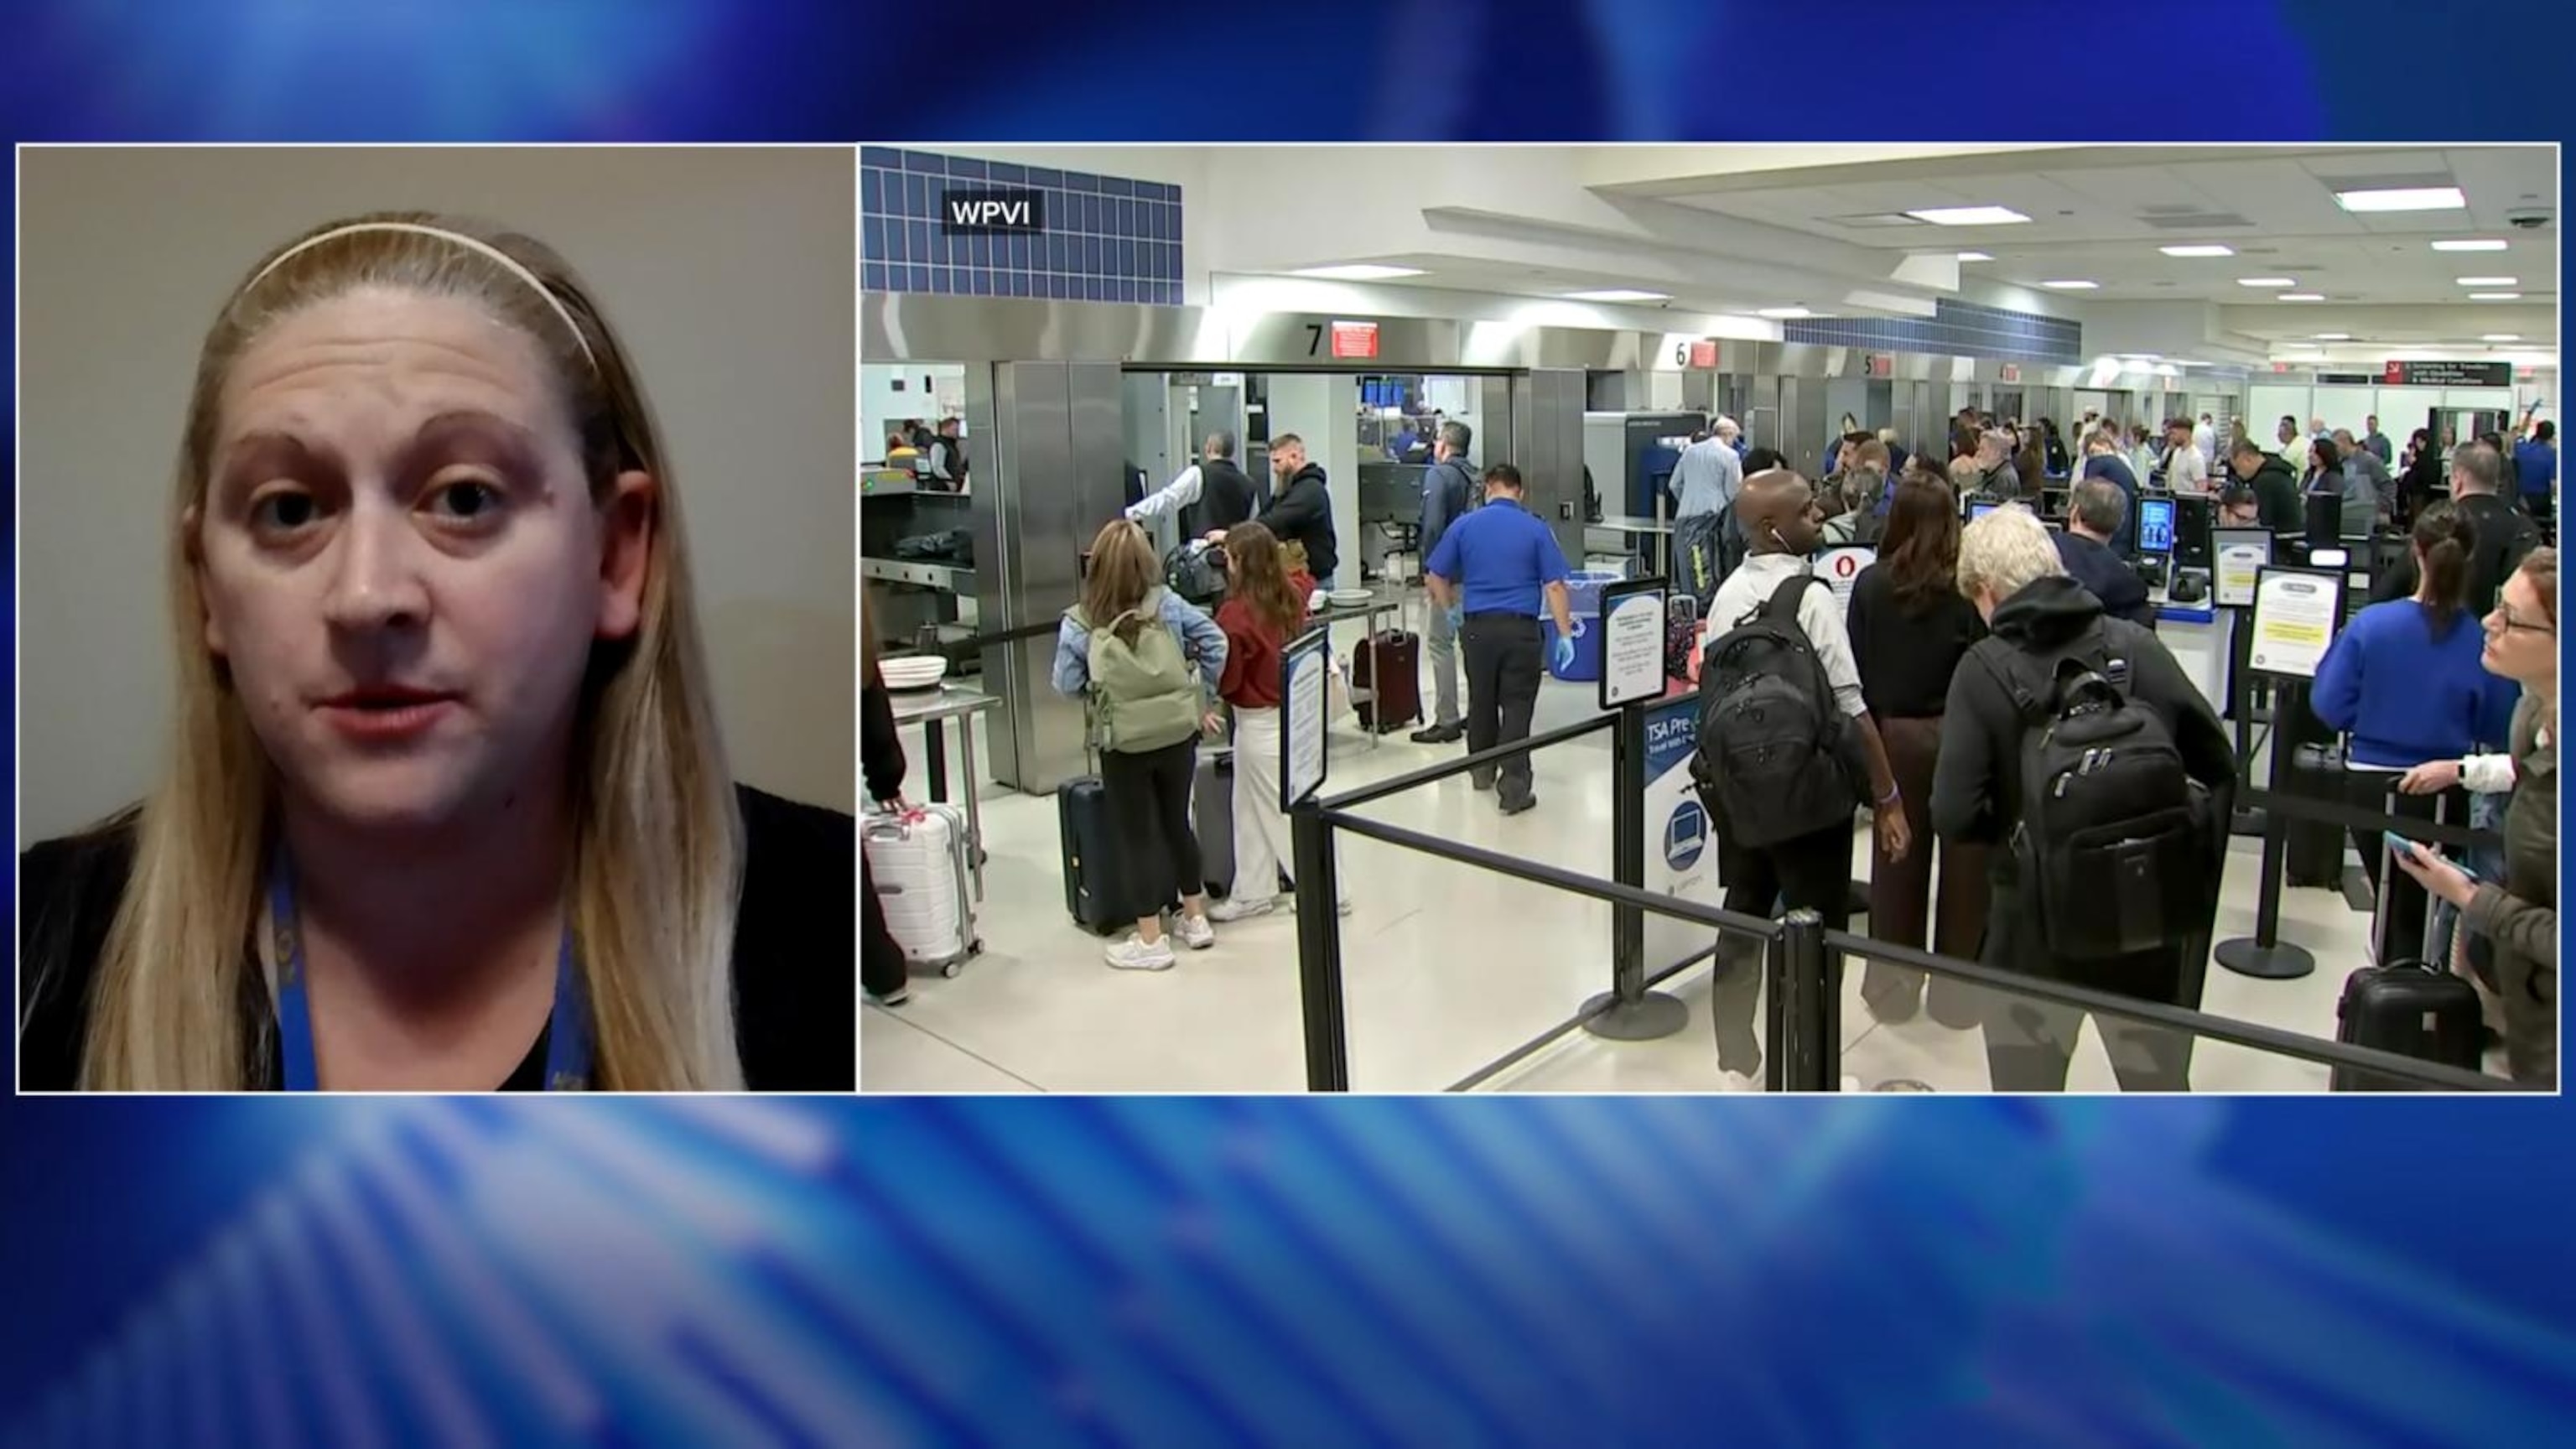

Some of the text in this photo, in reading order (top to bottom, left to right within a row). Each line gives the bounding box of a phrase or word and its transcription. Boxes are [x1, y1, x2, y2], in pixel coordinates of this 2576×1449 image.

[1306, 324, 1322, 356] 7
[1675, 342, 1685, 366] 6
[1865, 355, 1872, 375] 5
[1648, 721, 1669, 742] TSA
[1670, 717, 1690, 735] Pre
